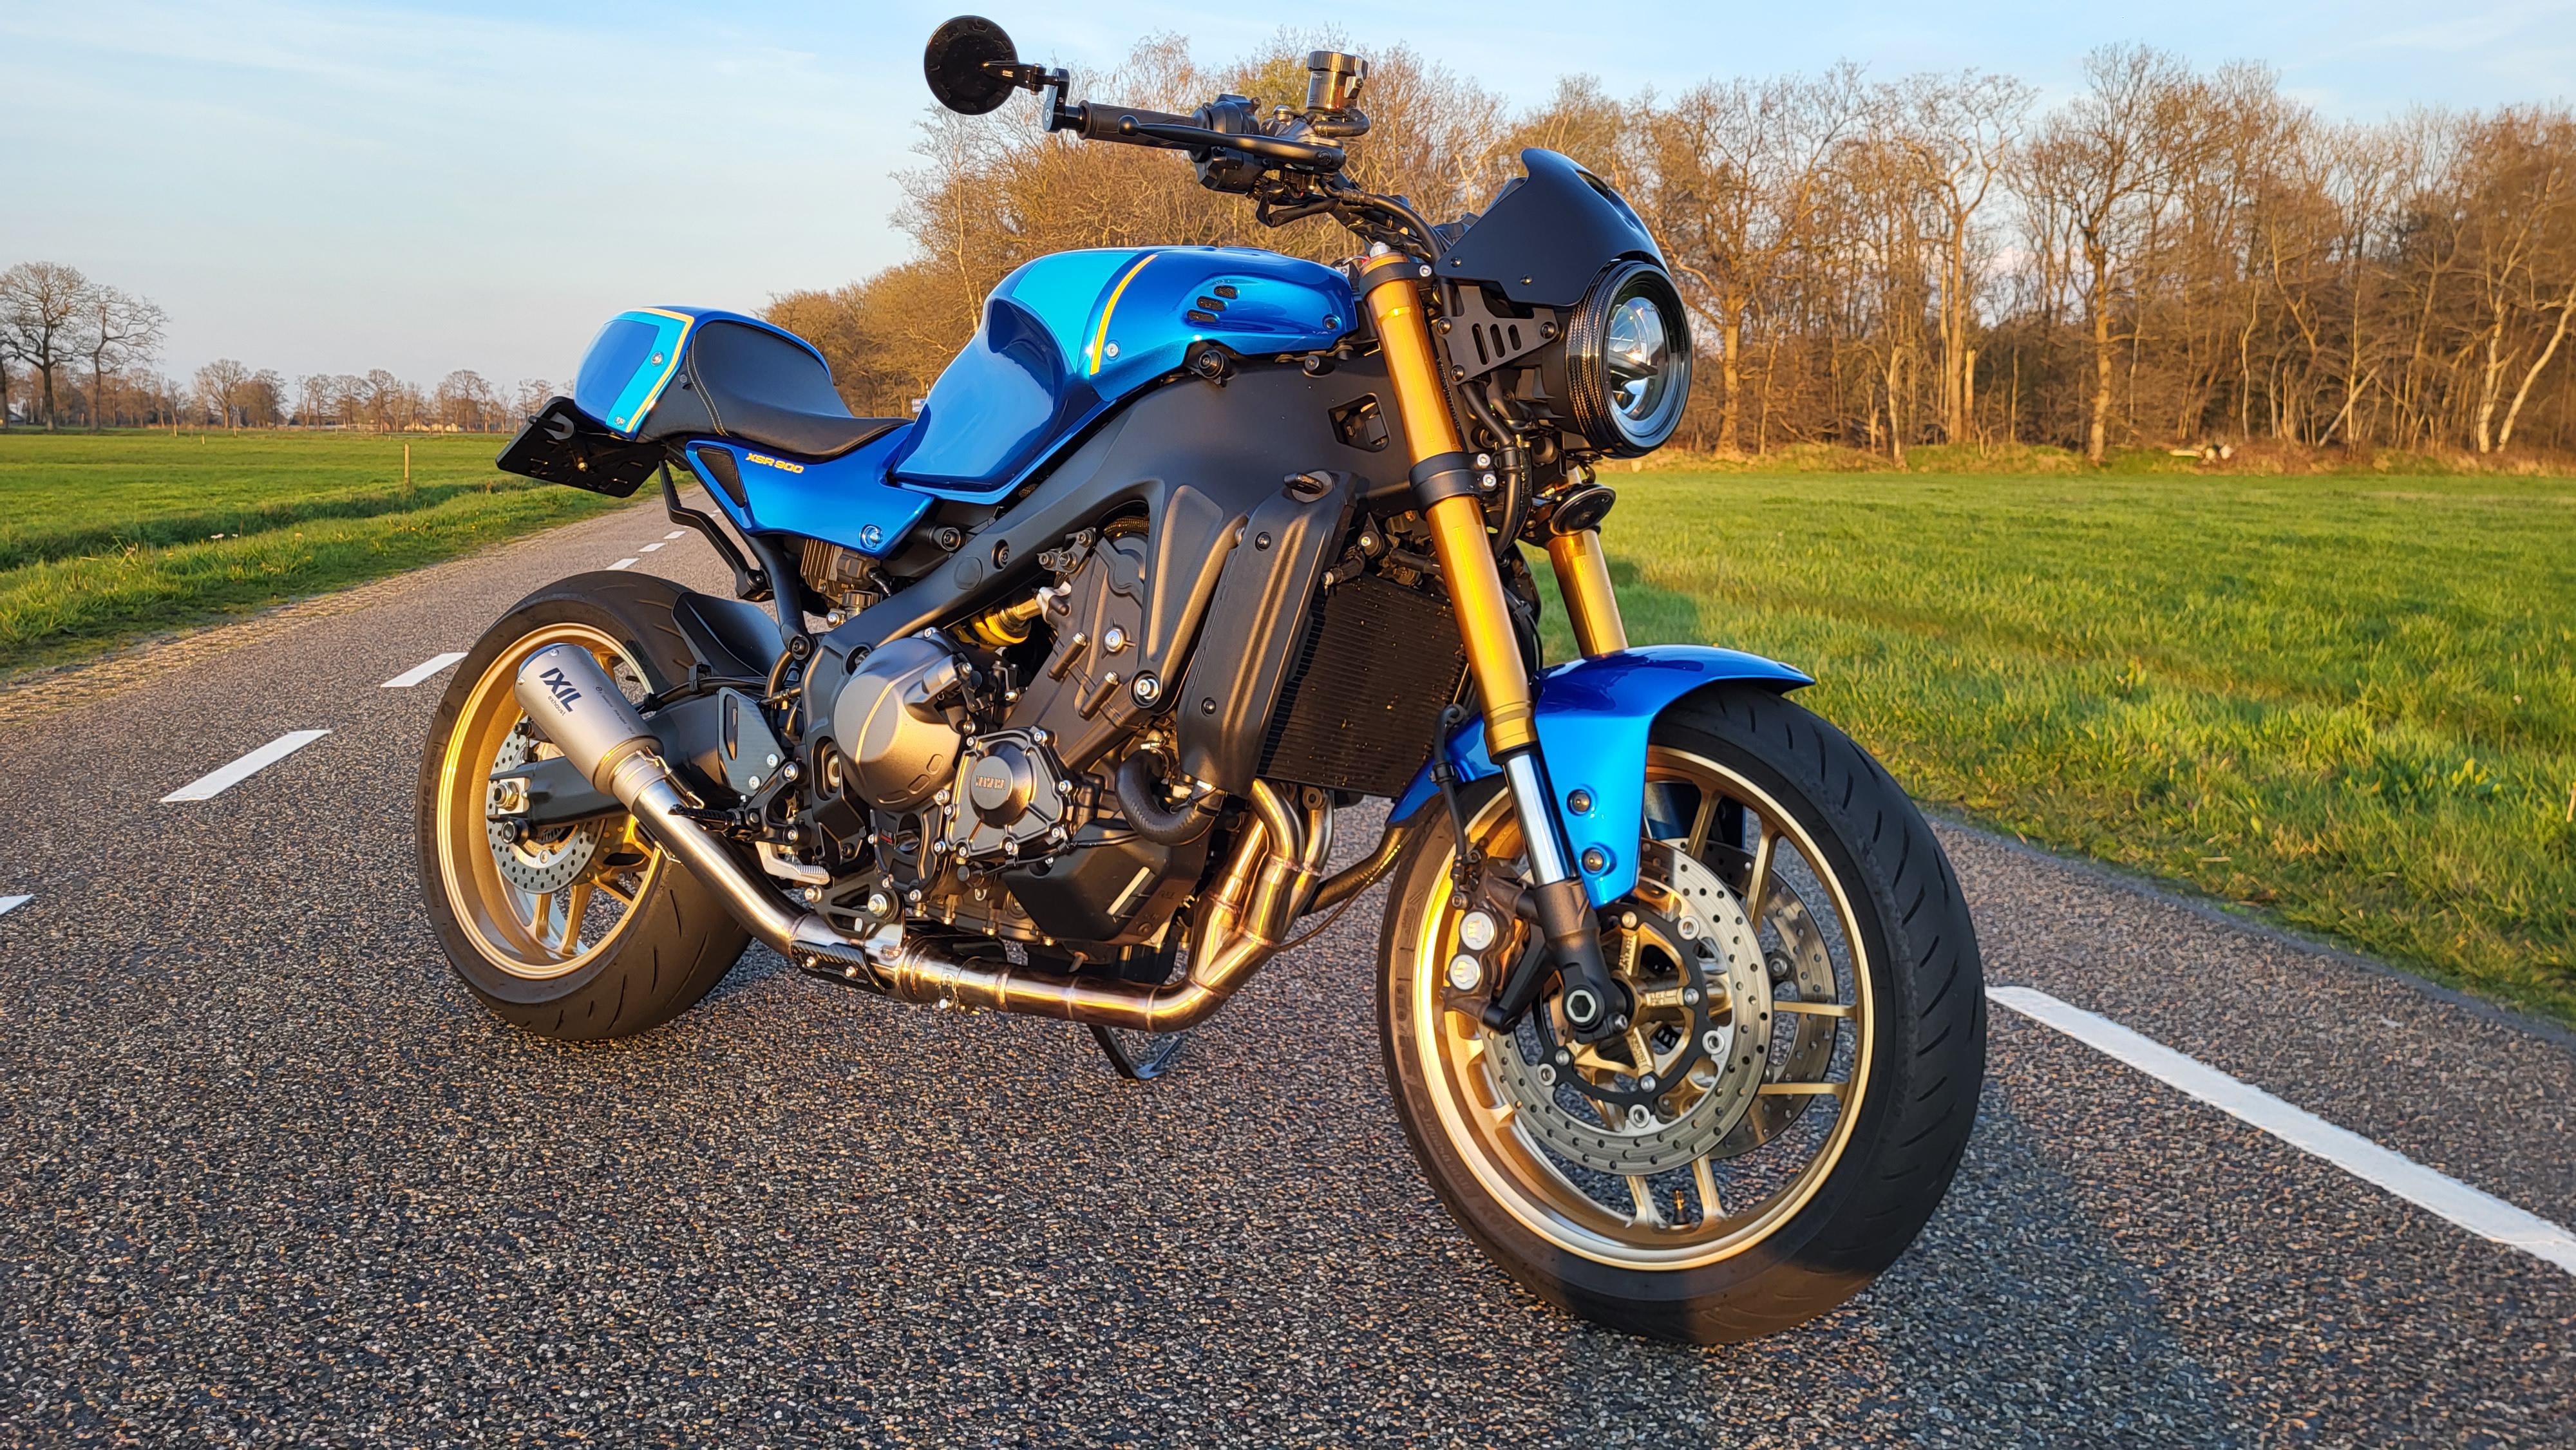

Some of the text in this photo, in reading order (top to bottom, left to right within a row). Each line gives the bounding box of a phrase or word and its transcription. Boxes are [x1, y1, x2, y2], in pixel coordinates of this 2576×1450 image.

[745, 453, 804, 473] XSR 900
[539, 667, 582, 713] IXIL
[547, 695, 566, 716] exhaust
